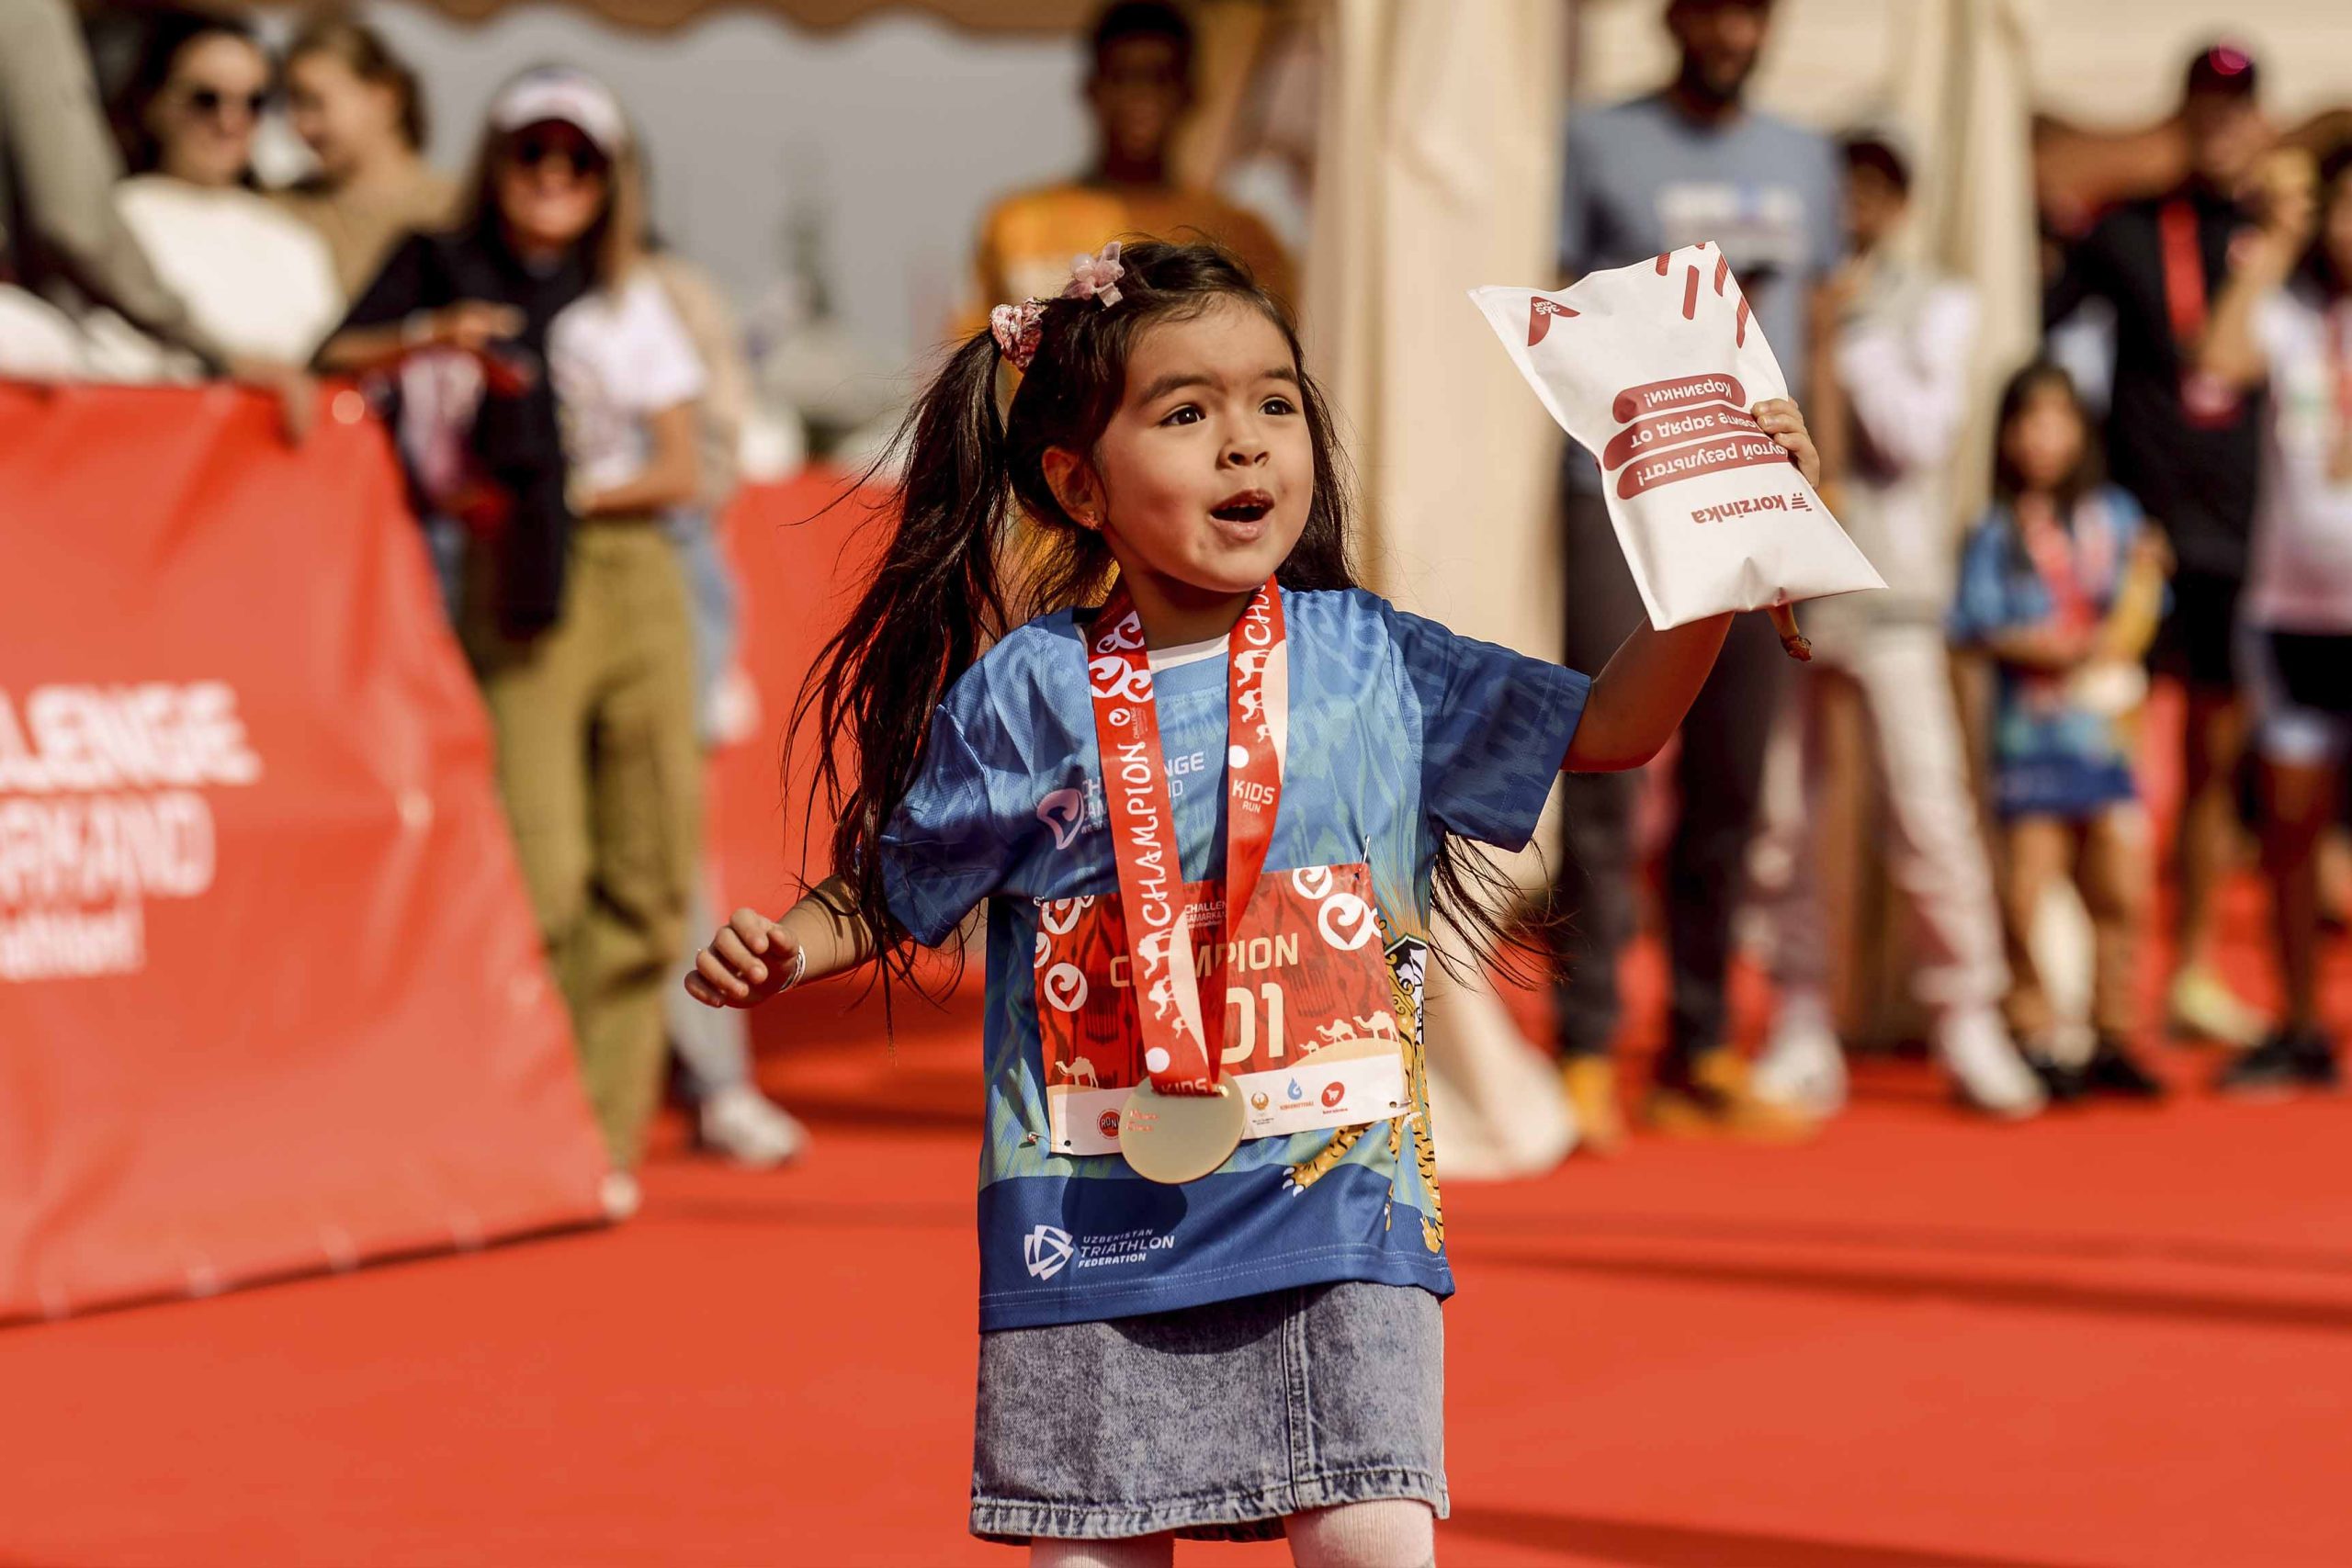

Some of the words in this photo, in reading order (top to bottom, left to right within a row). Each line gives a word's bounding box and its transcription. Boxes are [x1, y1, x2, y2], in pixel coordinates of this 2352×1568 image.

[1535, 304, 1561, 315] 365
[1644, 379, 1733, 408] Корзинки!
[1657, 415, 1715, 438] заряд
[1630, 431, 1653, 448] от
[1742, 440, 1788, 460] рутой
[1636, 442, 1738, 486] результат!
[1690, 494, 1788, 524] korzinka
[1232, 779, 1275, 805] KIDS
[1242, 800, 1261, 814] RUN
[1117, 741, 1172, 927] CHAMPION
[1080, 1235, 1175, 1258] TRIATHLON
[1083, 1228, 1154, 1244] UZBEKISTAN
[1078, 1252, 1147, 1269] FEDERATION
